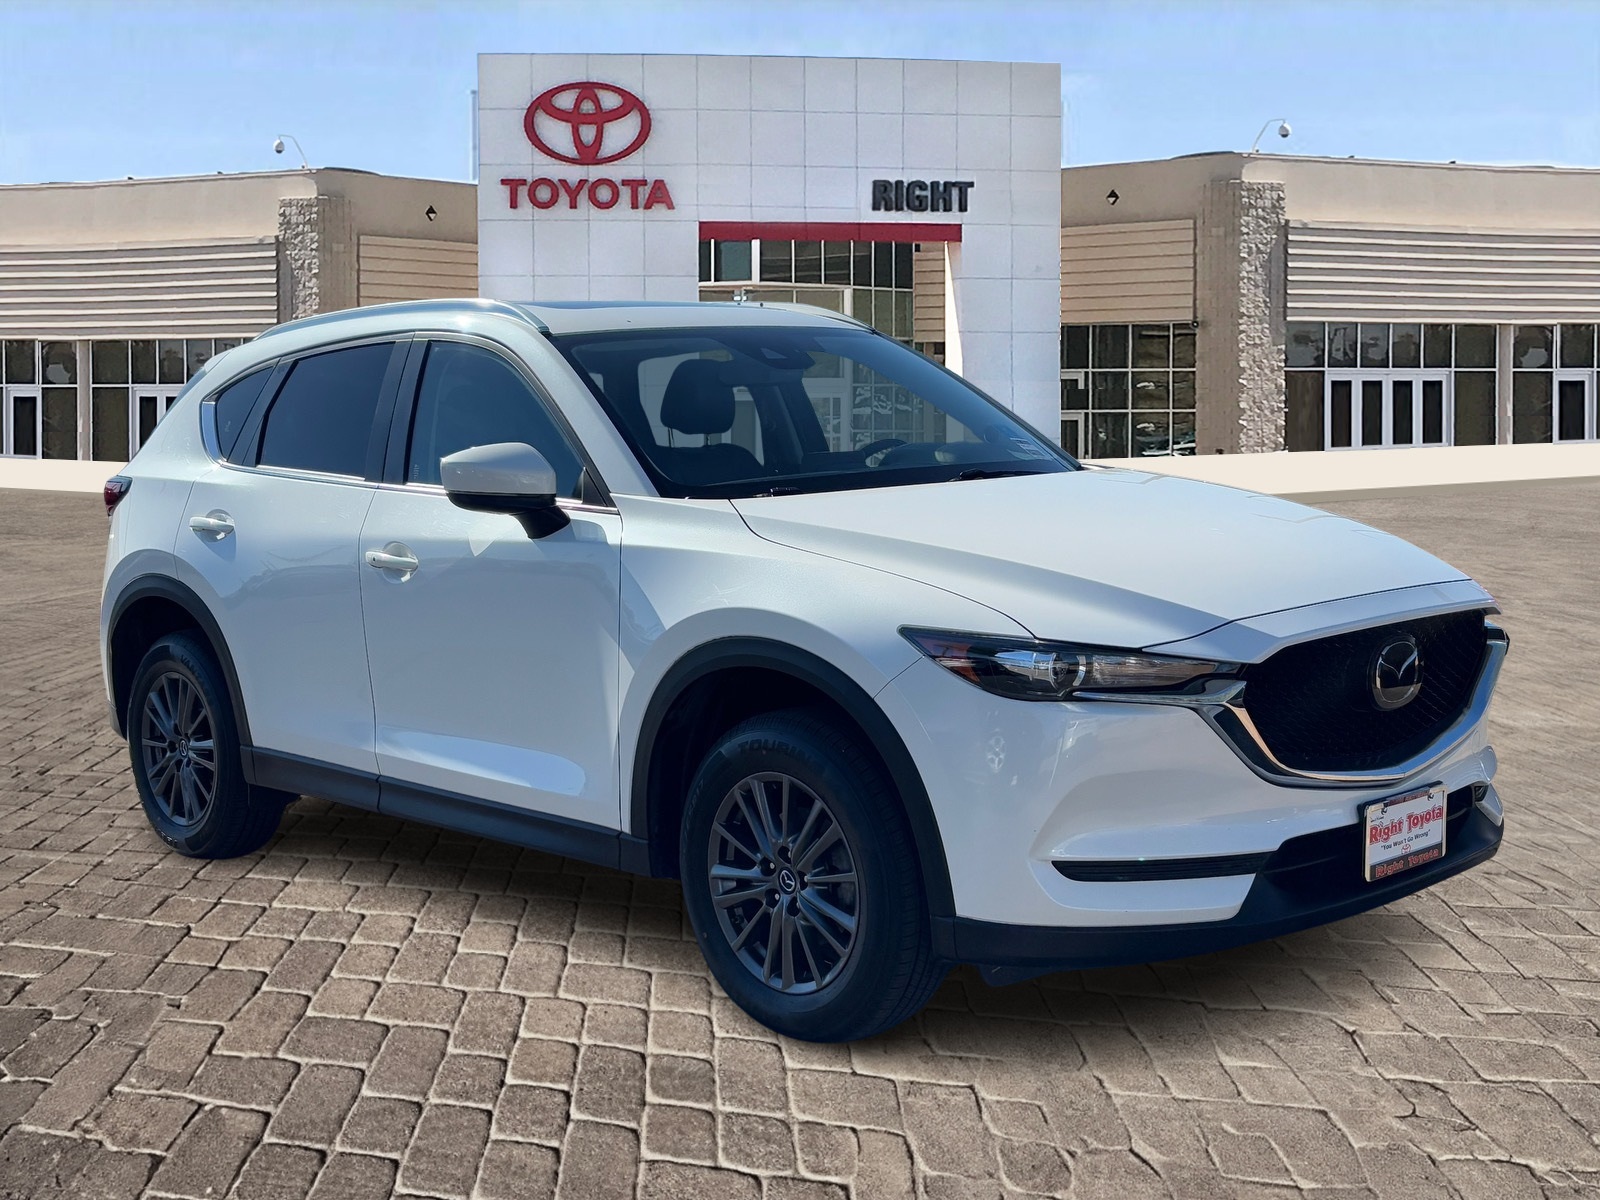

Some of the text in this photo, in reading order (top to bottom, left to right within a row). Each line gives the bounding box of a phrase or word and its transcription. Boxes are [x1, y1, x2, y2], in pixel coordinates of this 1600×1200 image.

[500, 178, 675, 210] TOYOTA
[871, 179, 975, 212] RIGHT
[1369, 804, 1443, 845] Right Toyota
[1393, 838, 1407, 847] Won't
[1414, 829, 1431, 840] Wrong"
[1376, 849, 1439, 877] Right Toyota
